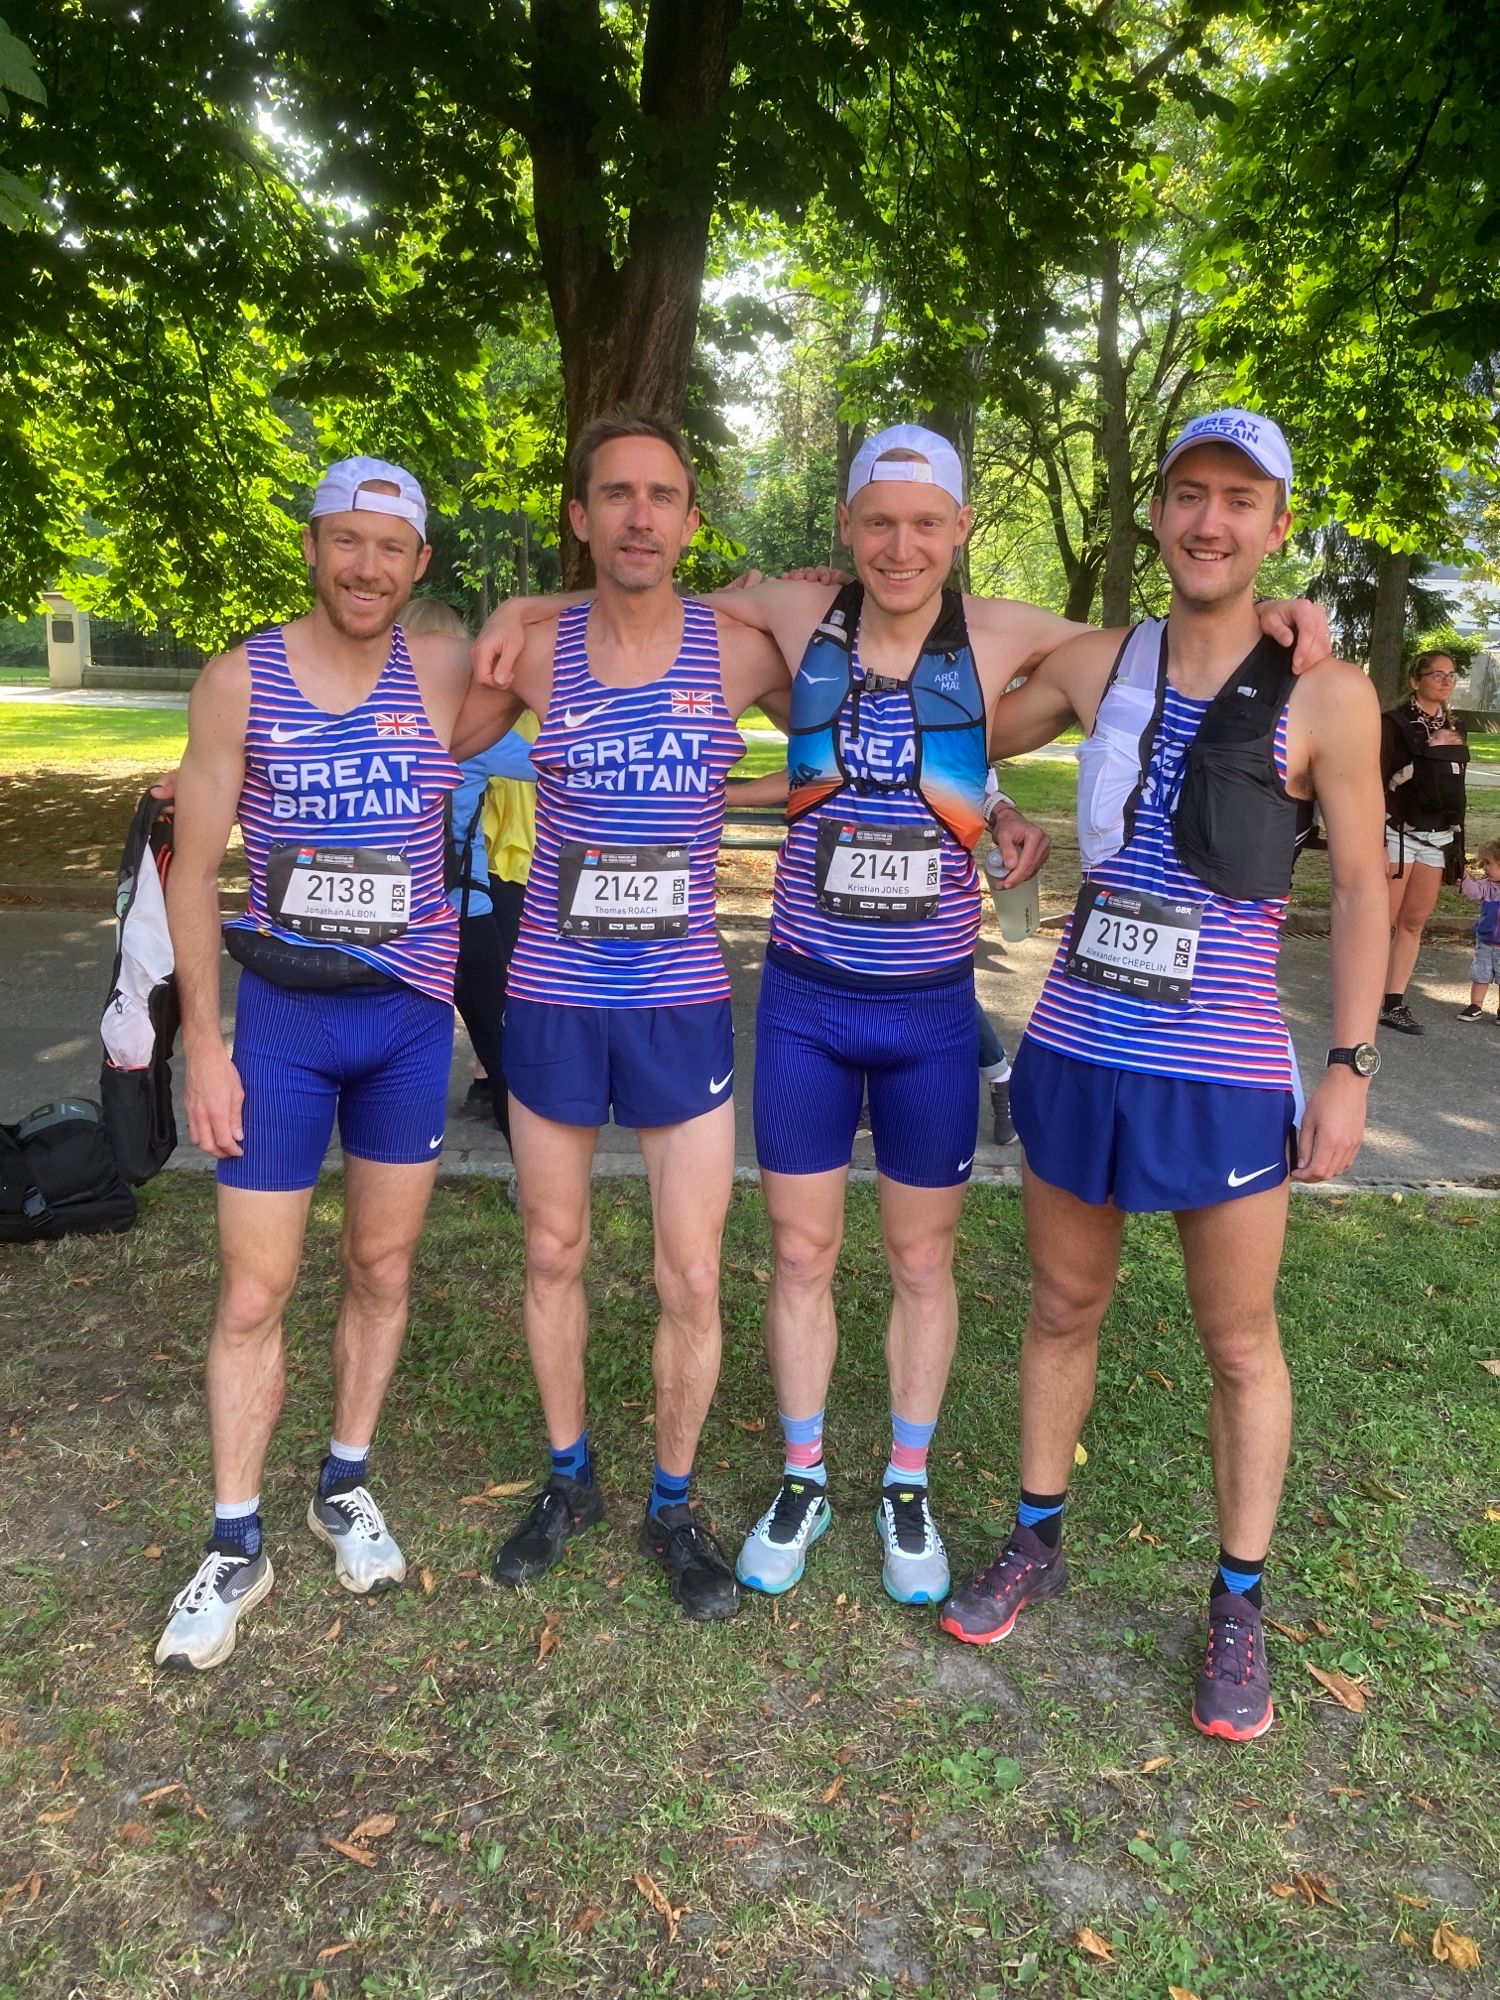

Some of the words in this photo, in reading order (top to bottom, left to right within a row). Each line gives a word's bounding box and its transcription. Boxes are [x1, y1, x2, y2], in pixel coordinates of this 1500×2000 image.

[1191, 417, 1261, 433] GREAT
[567, 732, 709, 769] GREAT
[839, 729, 916, 768] REA
[267, 755, 417, 791] GREAT
[566, 765, 708, 793] BRITAIN
[273, 787, 421, 819] BRITAIN
[666, 850, 681, 858] GBR
[850, 852, 910, 881] 2141
[307, 874, 375, 905] 2138
[594, 874, 659, 902] 2142
[847, 883, 880, 893] Kristian
[881, 886, 910, 894] JONES
[304, 905, 344, 916] Jonathan
[345, 908, 377, 919] ALBON
[595, 906, 627, 915] Thomas
[628, 906, 658, 915] ROACH
[1175, 905, 1192, 915] GBR
[1096, 917, 1159, 955] 2139
[1086, 947, 1121, 963] Alexander
[1122, 956, 1167, 973] CHEPELIN
